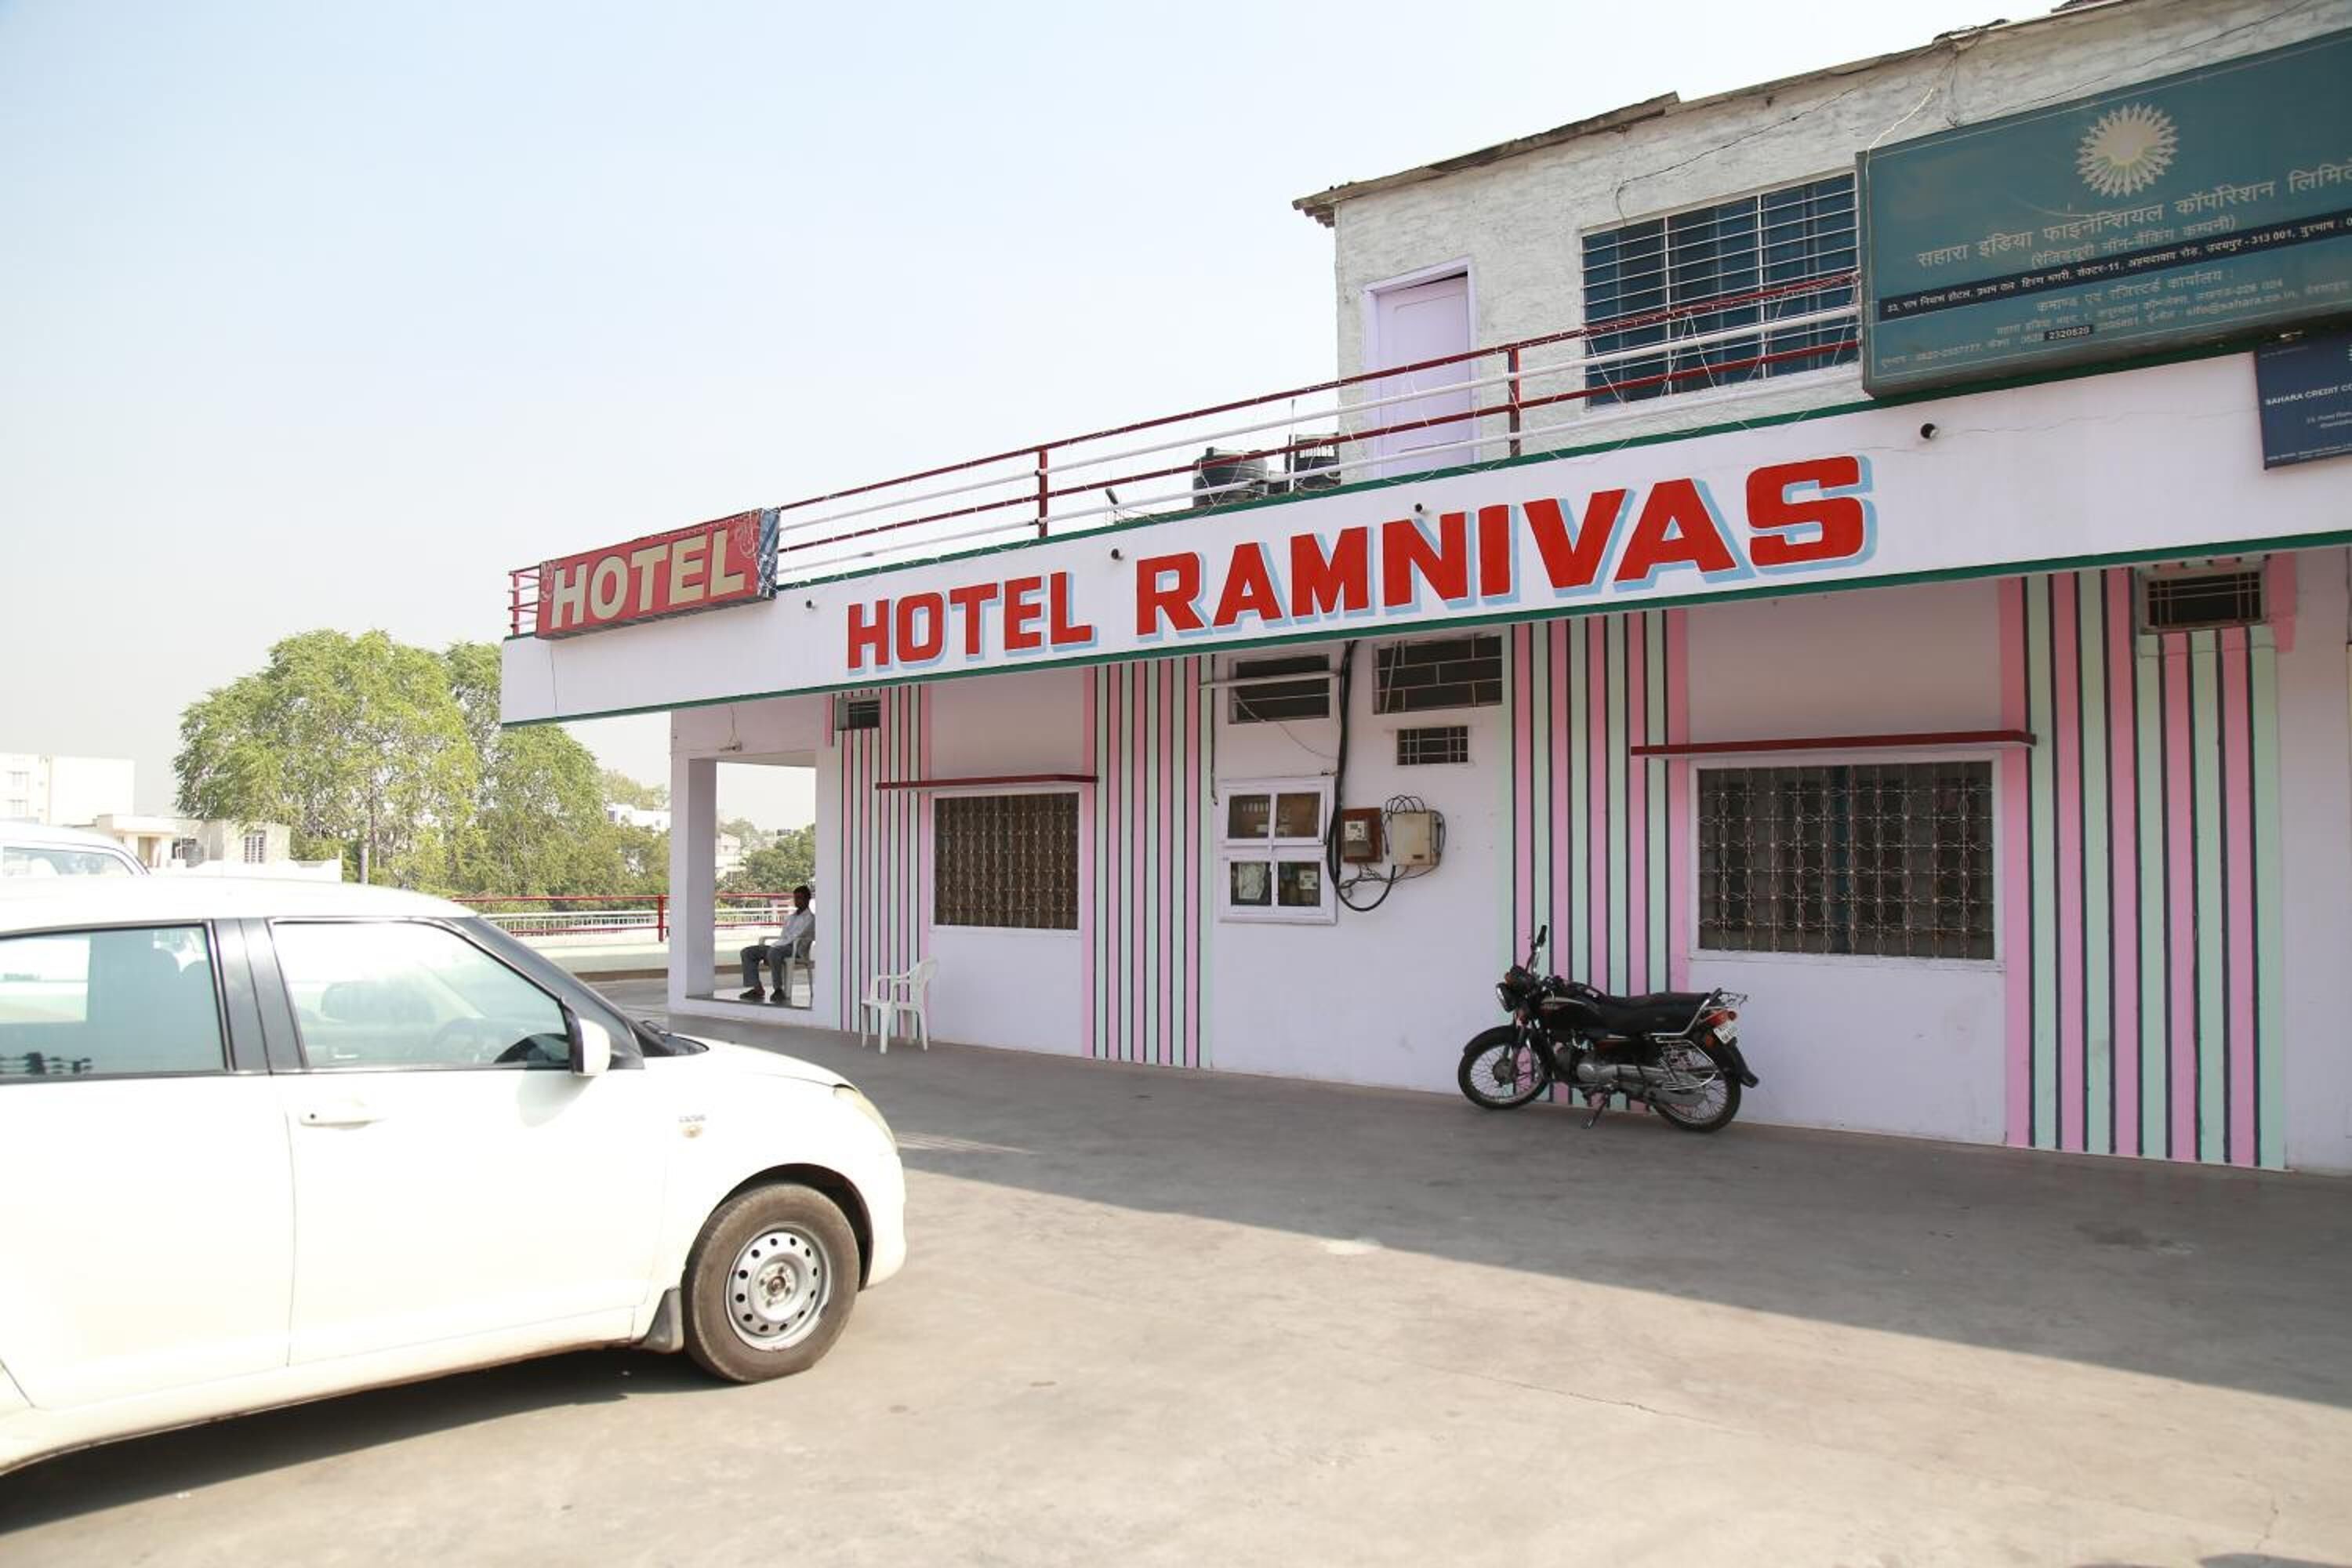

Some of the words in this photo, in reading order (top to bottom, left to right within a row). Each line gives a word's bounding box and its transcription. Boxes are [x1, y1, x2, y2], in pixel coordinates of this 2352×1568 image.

[1918, 244, 1970, 267] सहारा
[551, 529, 745, 628] HOTEL
[848, 572, 1095, 673] HOTEL
[1136, 455, 1871, 640] RAMNIVAS
